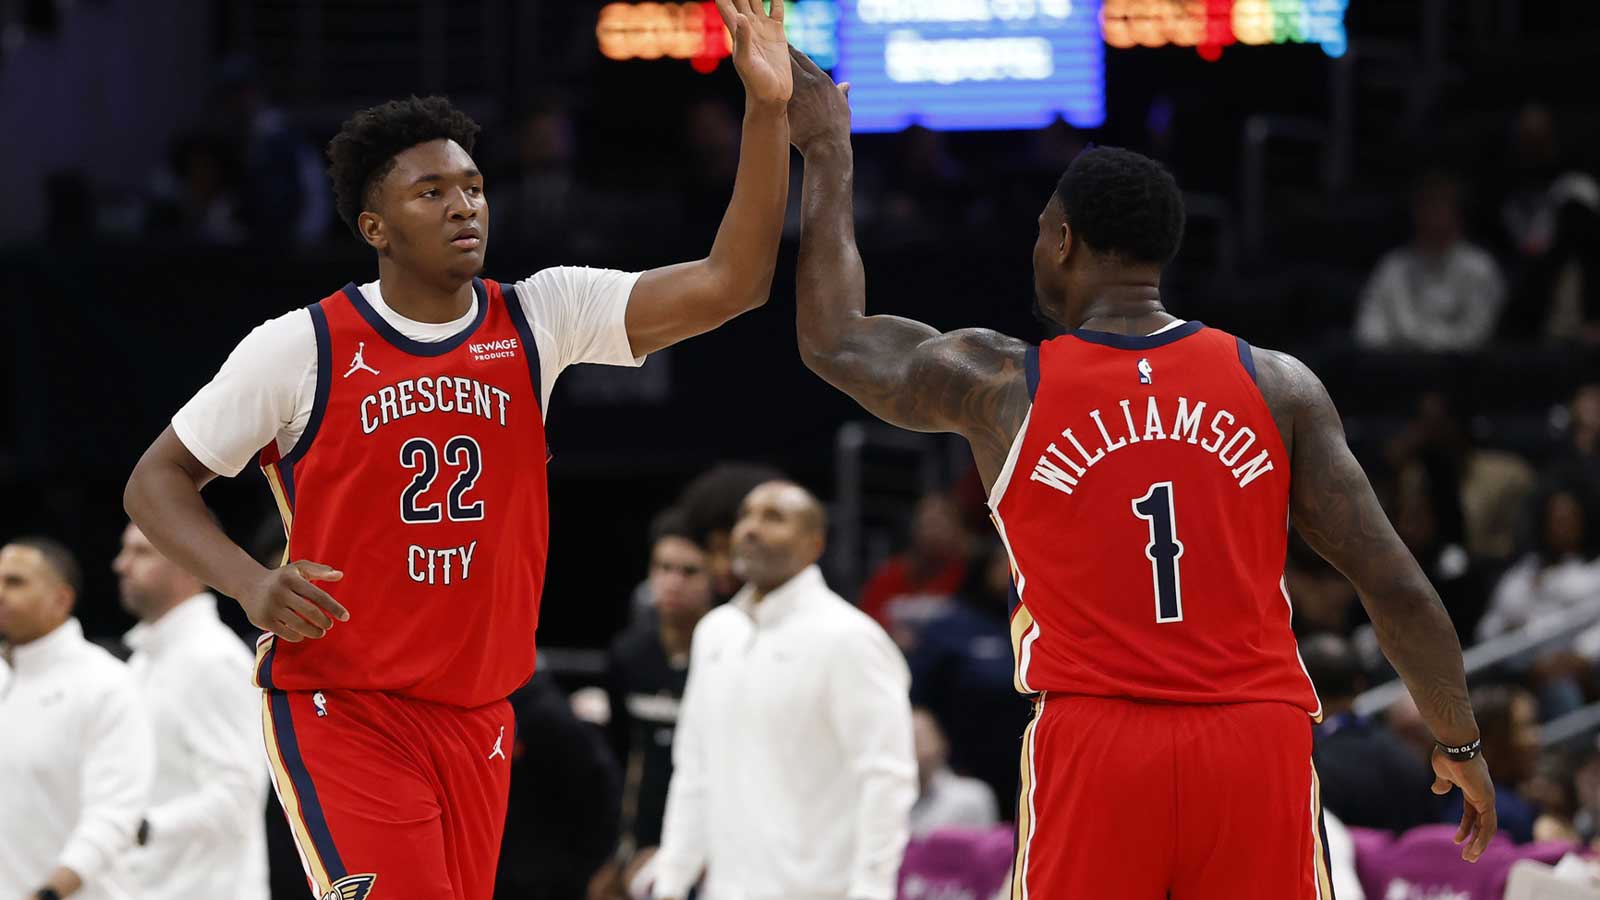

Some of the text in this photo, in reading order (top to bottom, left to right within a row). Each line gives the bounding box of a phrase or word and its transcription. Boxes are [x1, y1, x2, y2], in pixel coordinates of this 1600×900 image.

[469, 338, 517, 353] NEWAGE
[475, 350, 515, 360] PRODUCTS
[360, 375, 511, 435] CRESCENT
[1030, 396, 1274, 495] WILLIAMSON
[399, 435, 484, 524] 22
[407, 539, 477, 585] CITY
[1131, 481, 1184, 624] 1
